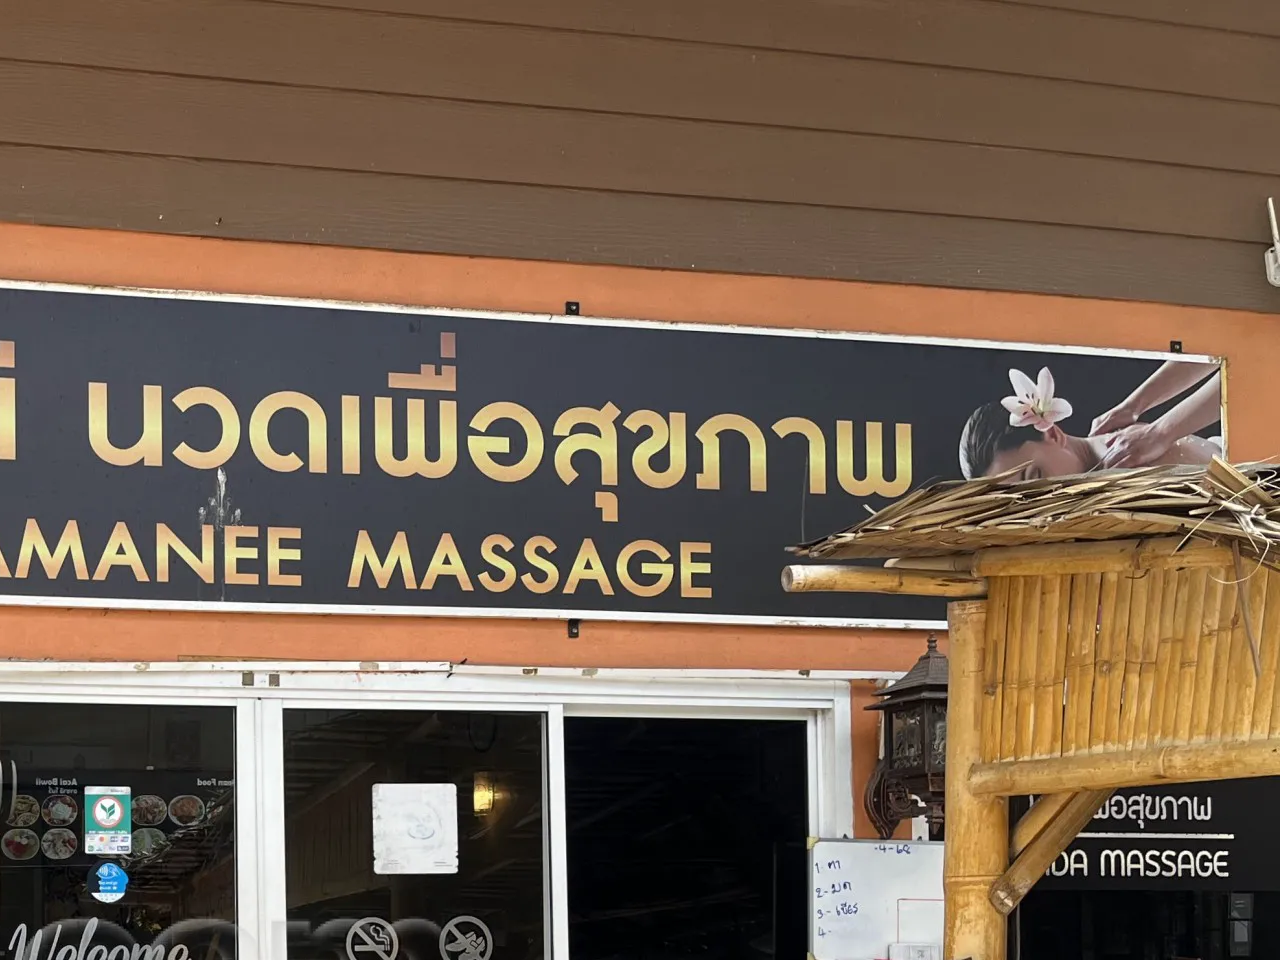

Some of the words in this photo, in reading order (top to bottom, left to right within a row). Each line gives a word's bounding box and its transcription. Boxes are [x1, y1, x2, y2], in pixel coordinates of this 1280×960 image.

[87, 331, 913, 523] นวดเพื่อสุขภาพ
[347, 529, 714, 599] MASSAGE
[1100, 850, 1229, 878] MASSAGE
